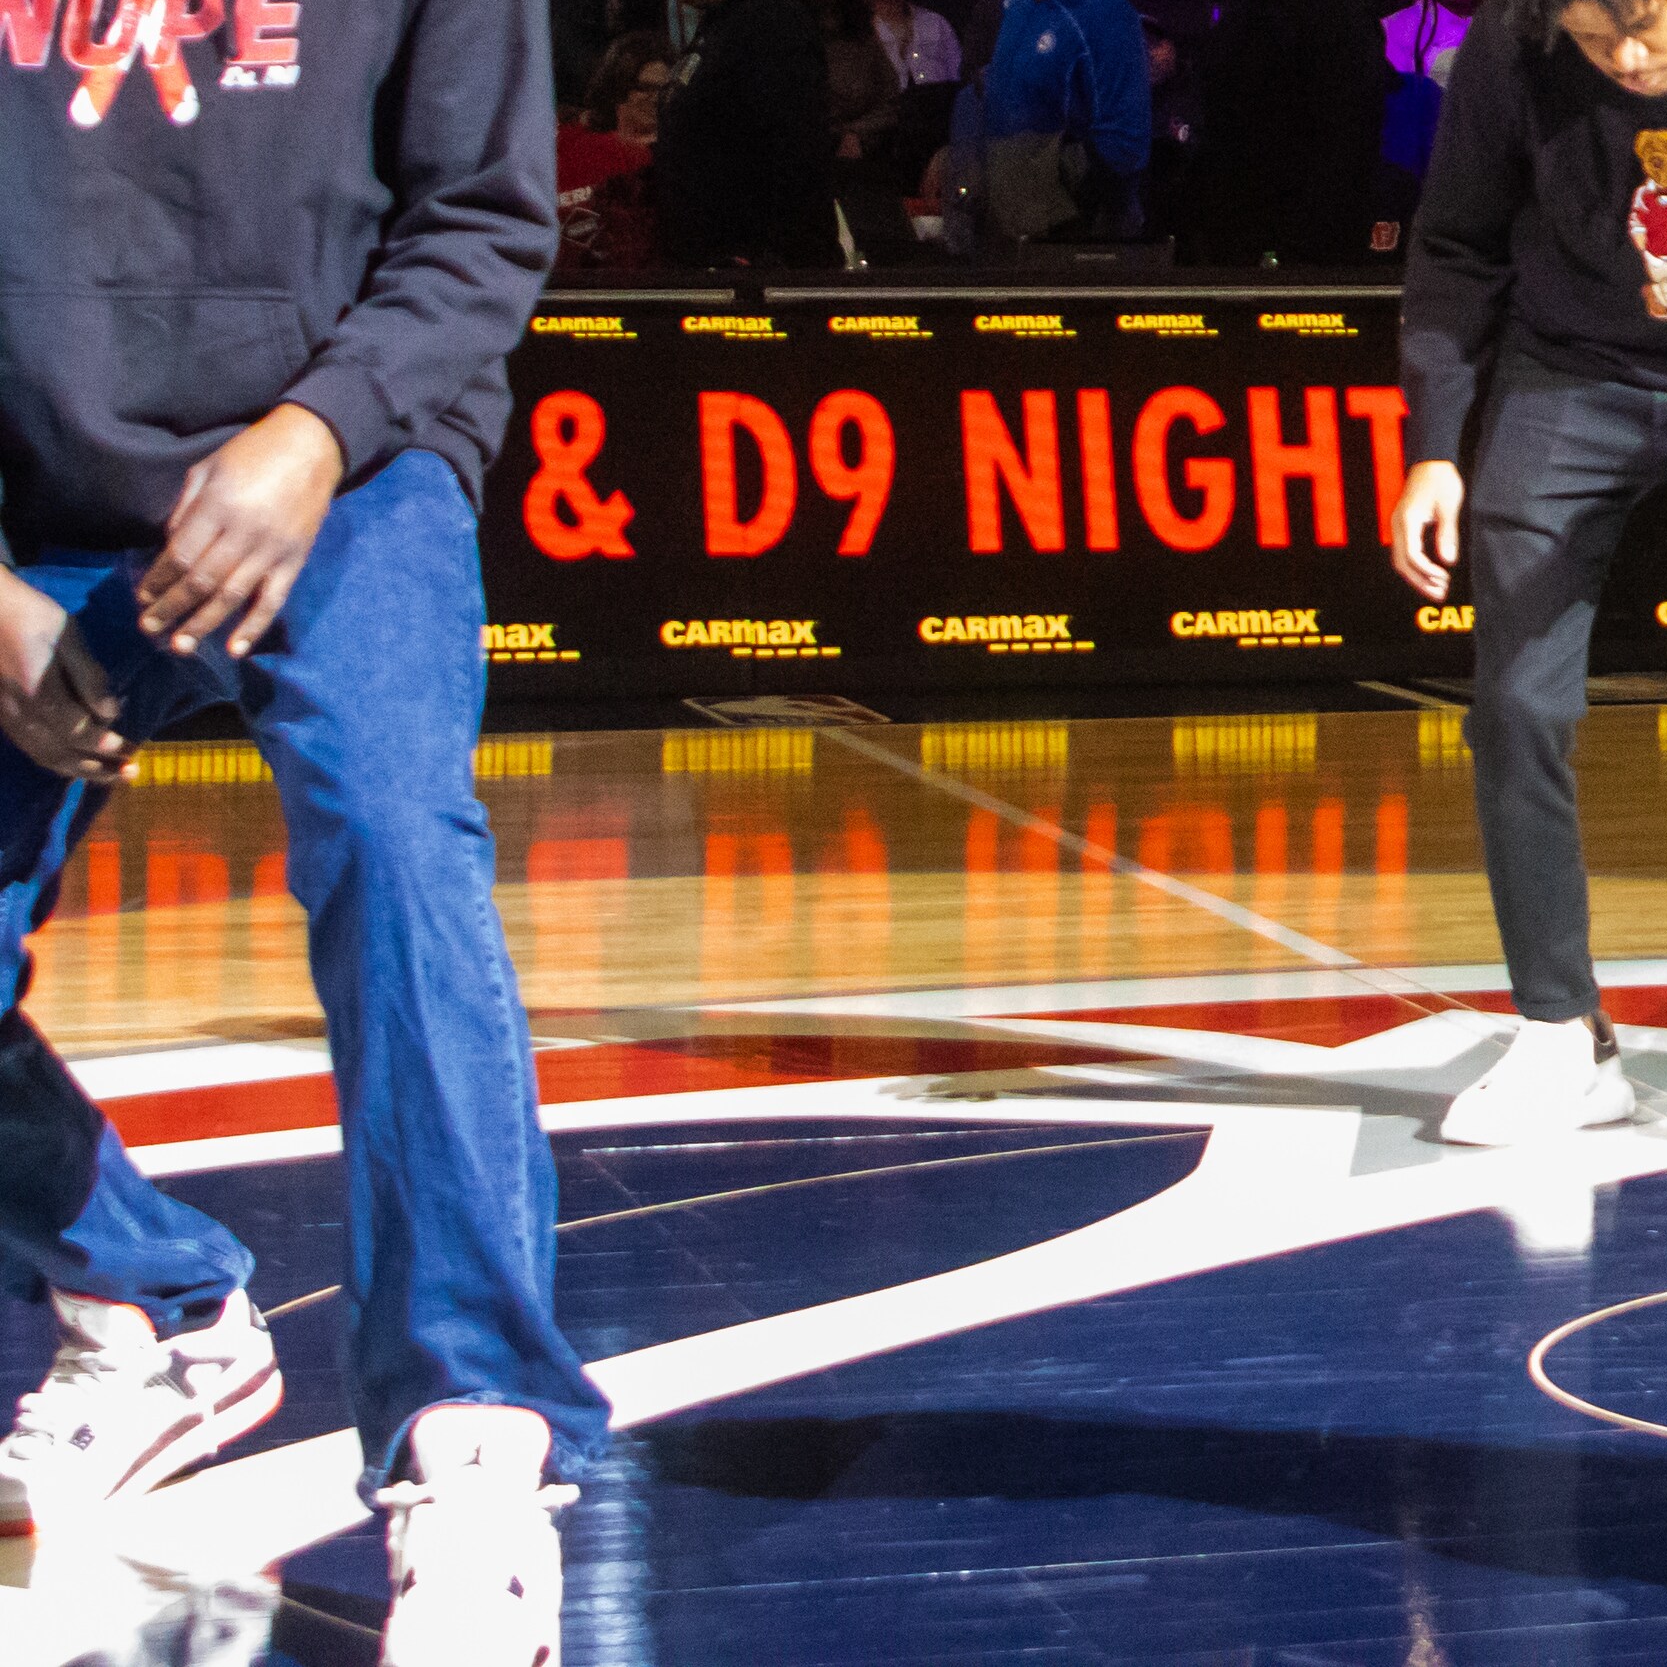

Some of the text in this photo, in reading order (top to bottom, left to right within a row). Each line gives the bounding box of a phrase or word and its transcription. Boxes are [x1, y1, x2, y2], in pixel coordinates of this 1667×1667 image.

[522, 385, 1411, 562] & D9 NIGHT
[479, 623, 558, 650] max
